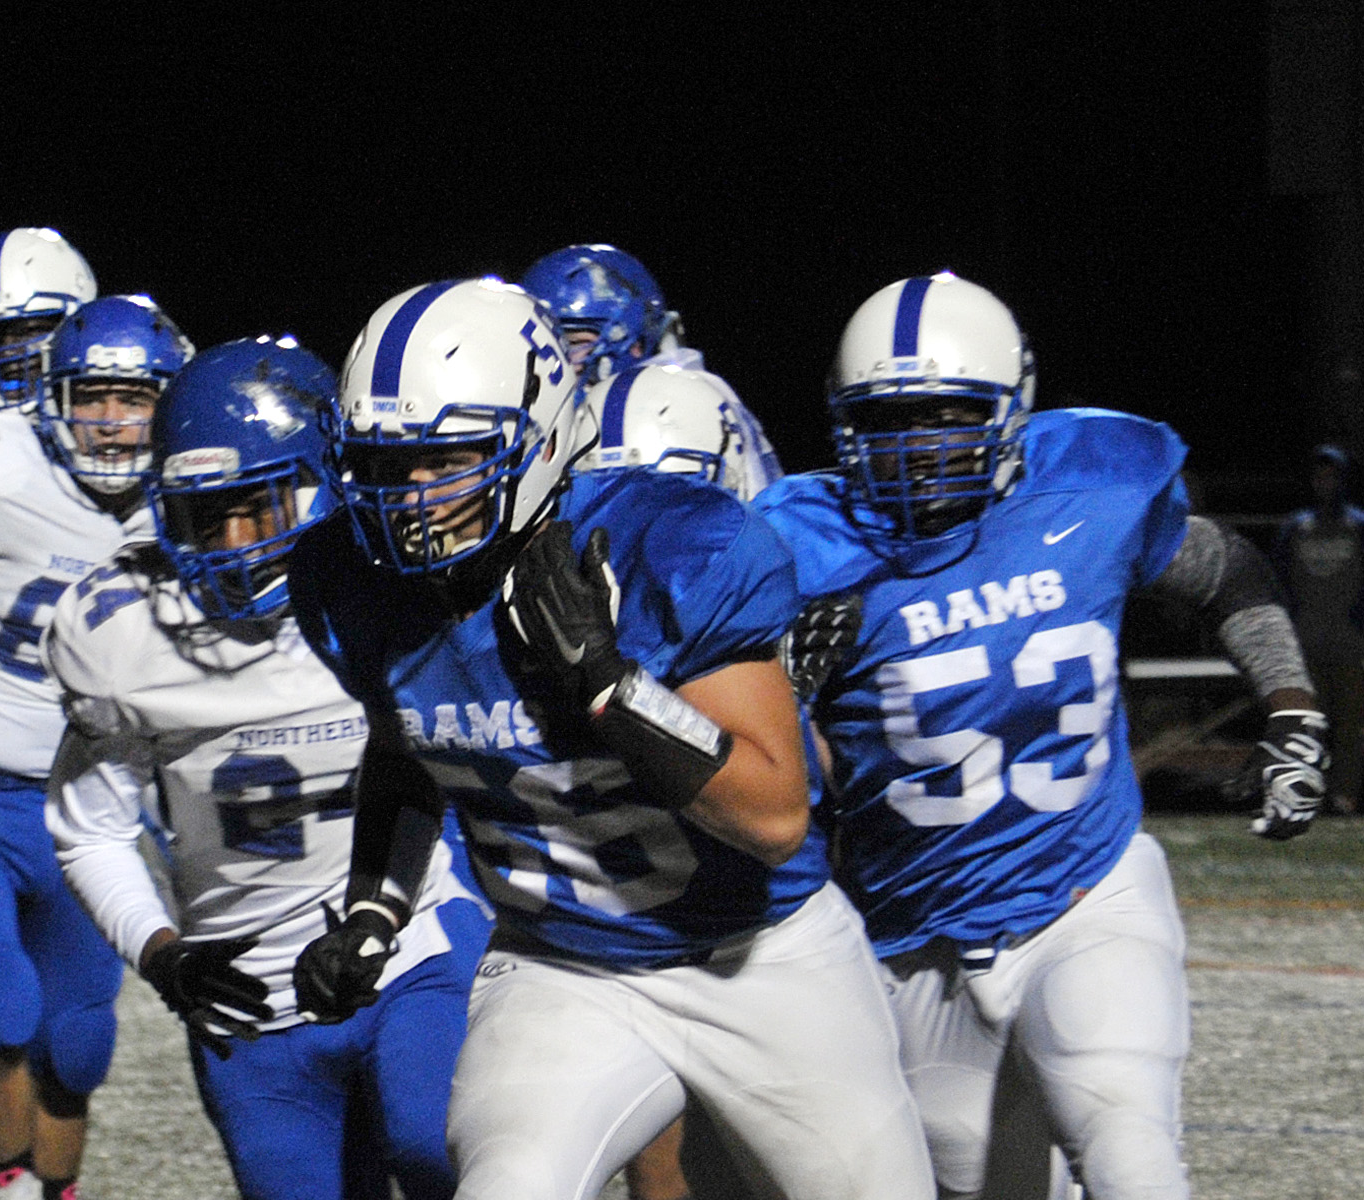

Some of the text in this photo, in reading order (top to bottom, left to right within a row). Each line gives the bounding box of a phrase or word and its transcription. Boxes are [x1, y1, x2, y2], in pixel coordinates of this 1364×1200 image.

[899, 569, 1067, 645] RAMS
[394, 700, 544, 750] RAMS
[875, 620, 1118, 827] 53
